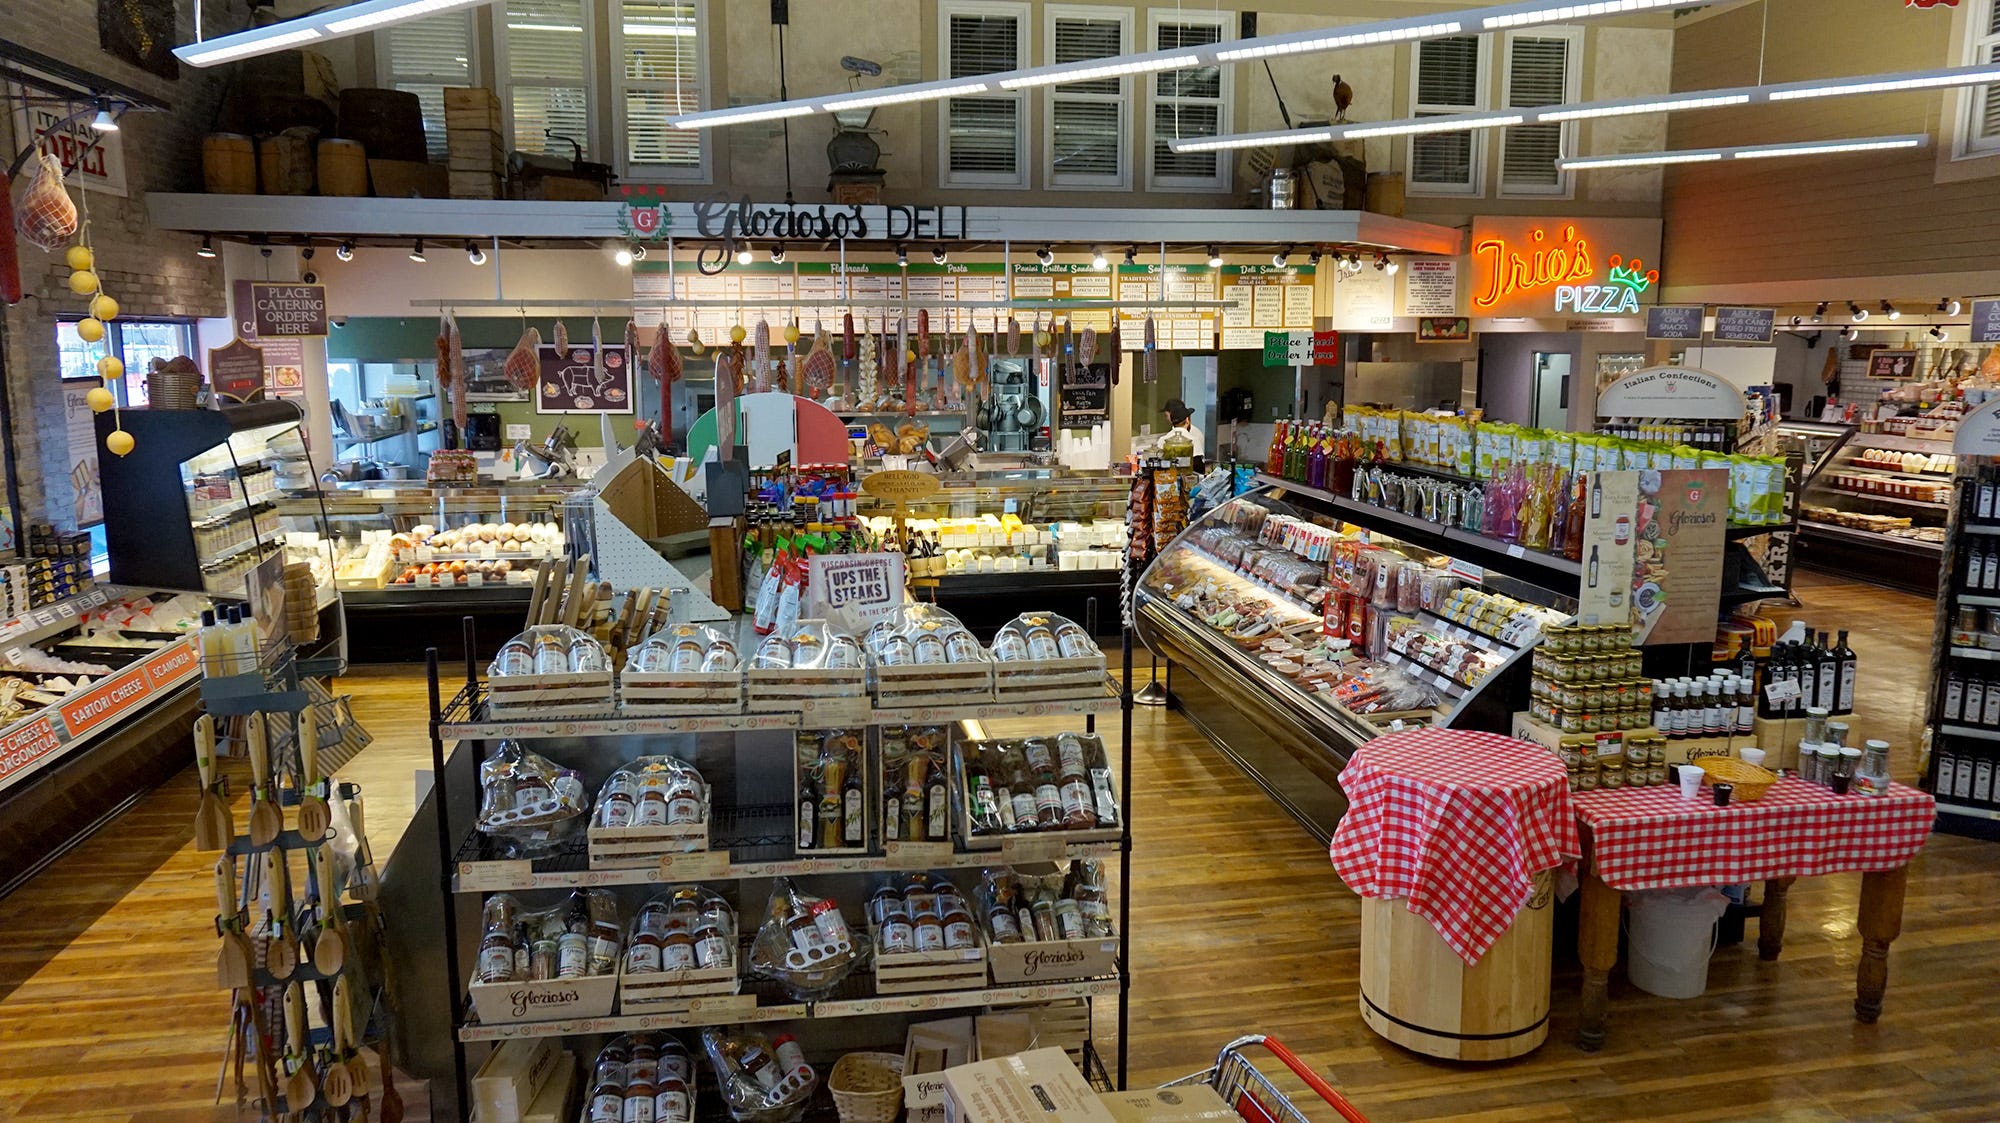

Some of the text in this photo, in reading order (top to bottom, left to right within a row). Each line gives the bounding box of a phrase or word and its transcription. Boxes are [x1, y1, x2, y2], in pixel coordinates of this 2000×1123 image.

[37, 110, 99, 141] ITALIAN
[35, 128, 107, 177] DELI
[637, 211, 652, 227] G
[887, 204, 966, 240] DELI
[830, 263, 869, 274] Flabreads
[947, 263, 968, 273] Pasta
[1014, 264, 1038, 273] Panini
[1042, 264, 1067, 273] Grilled
[1148, 264, 1187, 274] Sadwiches
[1240, 265, 1256, 274] Deli
[1476, 225, 1593, 307] Trio's
[268, 287, 311, 298] PLACE
[257, 300, 323, 311] CATERING
[1555, 285, 1640, 314] PIZZA
[265, 311, 318, 322] ORDERS
[1718, 317, 1736, 325] NUTS
[1745, 318, 1772, 326] CANDY
[275, 323, 310, 334] HERE
[1270, 337, 1301, 346] Place
[1307, 336, 1334, 346] Food
[1268, 351, 1334, 360] Order Here
[1624, 372, 1718, 389] Italian Confections
[1689, 490, 1700, 500] G
[821, 558, 892, 569] WISCONSIN CHEESE
[833, 567, 881, 586] UPS THE
[834, 583, 883, 602] STEAKS
[869, 608, 880, 616] THE
[152, 652, 190, 680] SCAMORZA
[71, 679, 144, 726] SARTORI CHEESE
[7, 721, 51, 751] CHEESE &
[0, 735, 58, 774] ORGONZOLA
[1024, 950, 1085, 976] Glorioso's
[510, 990, 579, 1017] Glorioso's
